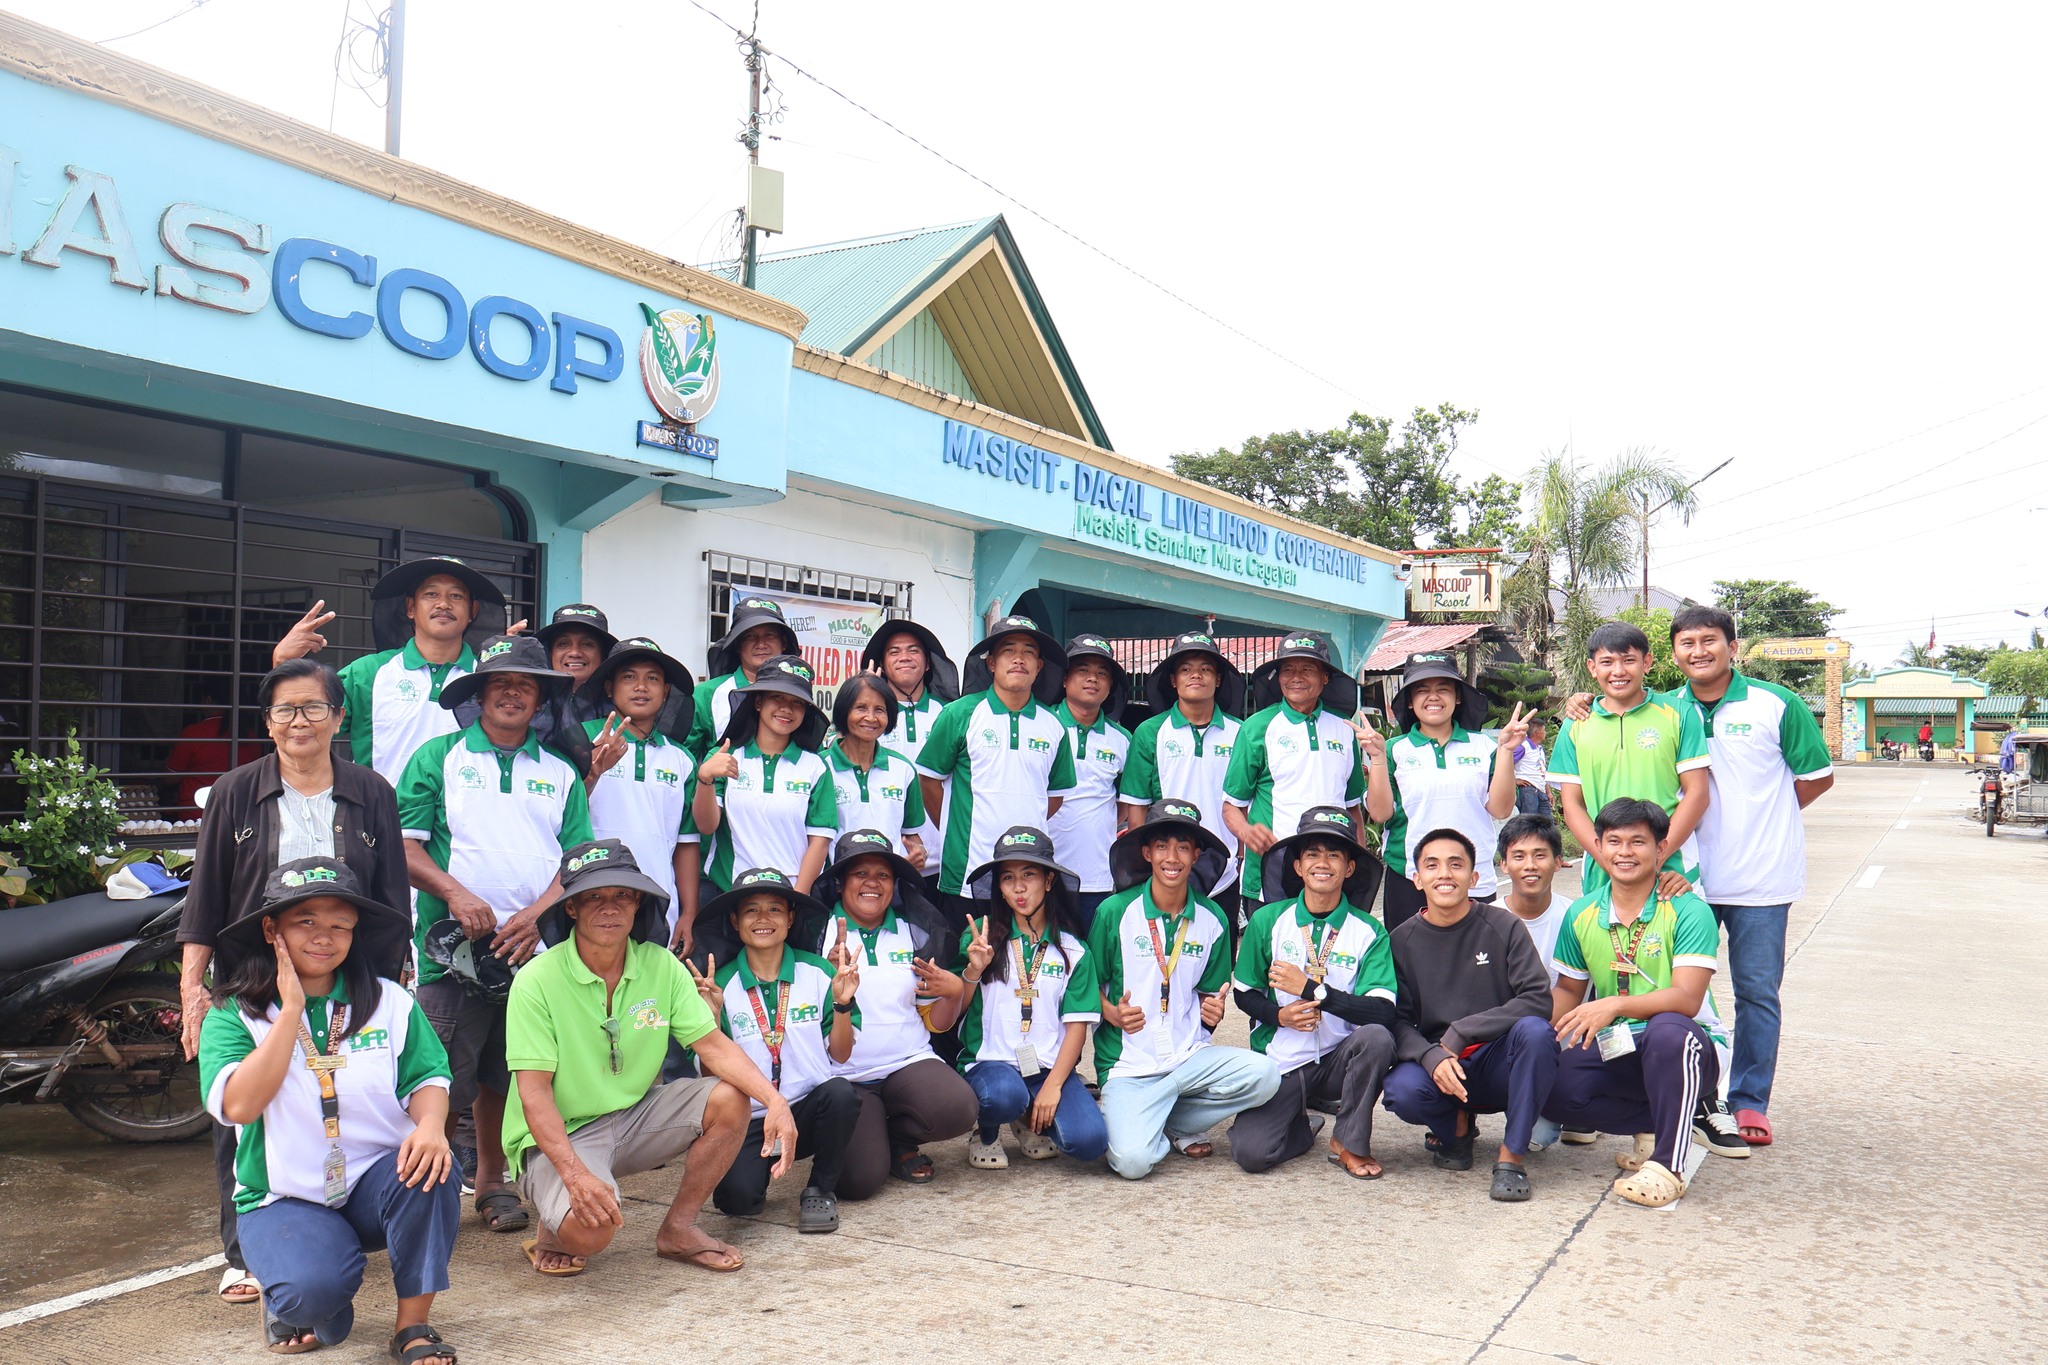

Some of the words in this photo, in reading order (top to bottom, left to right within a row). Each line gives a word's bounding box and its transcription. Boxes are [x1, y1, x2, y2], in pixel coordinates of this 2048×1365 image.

[1074, 463, 1152, 522] DACAL
[1162, 491, 1269, 556] LIVELIHOOD
[1275, 530, 1368, 585] COOPERATIVE
[1144, 527, 1209, 565] Sanchez
[1246, 554, 1297, 588] Cagayan
[1422, 577, 1472, 593] MASCOOP
[1434, 593, 1471, 607] Resort
[790, 615, 817, 632] HERE!!!
[828, 618, 873, 637] MASCOOP
[1763, 647, 1813, 656] KALIDAD
[845, 649, 864, 681] RI
[1725, 722, 1751, 734] DFP
[1027, 738, 1050, 751] DFP
[655, 768, 679, 785] DFP
[526, 779, 555, 796] DFP
[786, 780, 811, 794] DFP
[881, 786, 903, 799] DFP
[304, 867, 337, 881] DFP
[72, 944, 124, 966] HONDA
[1328, 951, 1356, 967] DFP
[1040, 963, 1064, 976] DFP
[790, 1004, 818, 1021] DFP
[327, 1014, 339, 1052] SANCHEZ
[349, 1028, 388, 1050] DFP
